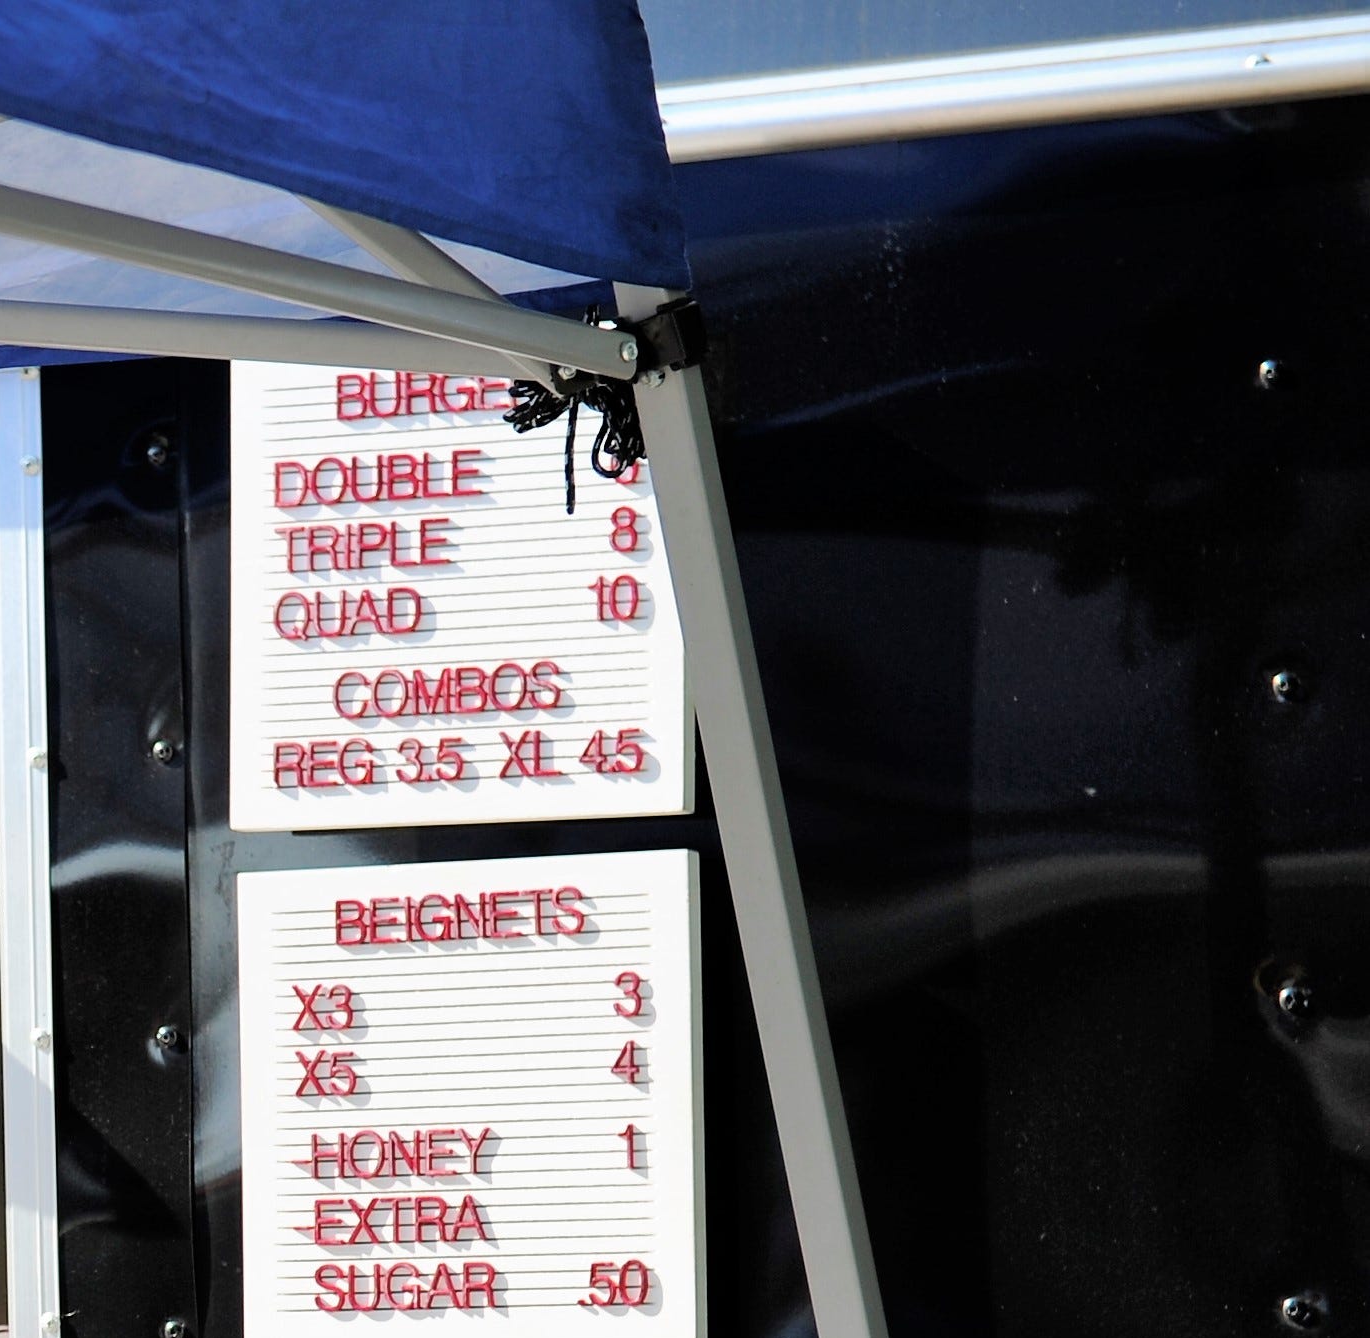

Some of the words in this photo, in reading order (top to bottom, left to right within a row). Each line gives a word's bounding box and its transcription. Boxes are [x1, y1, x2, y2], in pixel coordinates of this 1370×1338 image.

[336, 372, 519, 421] BURGE
[273, 449, 483, 508] DOUBLE
[274, 518, 452, 574] TRIPLE
[610, 506, 639, 553] 8
[273, 587, 423, 642] QUAD
[588, 575, 640, 622] 10
[332, 661, 563, 719] COMBOS
[273, 738, 374, 788] REG
[395, 738, 464, 784] 3.5
[499, 730, 562, 780] XL
[579, 728, 646, 774] 4.5
[335, 886, 587, 947] BEIGNETS
[292, 983, 355, 1032] X3
[613, 971, 643, 1018] 3
[295, 1050, 357, 1098] X5
[611, 1041, 641, 1085] 4
[617, 1124, 636, 1170] 1
[314, 1261, 498, 1313] SUGAR
[578, 1258, 650, 1308] .50
